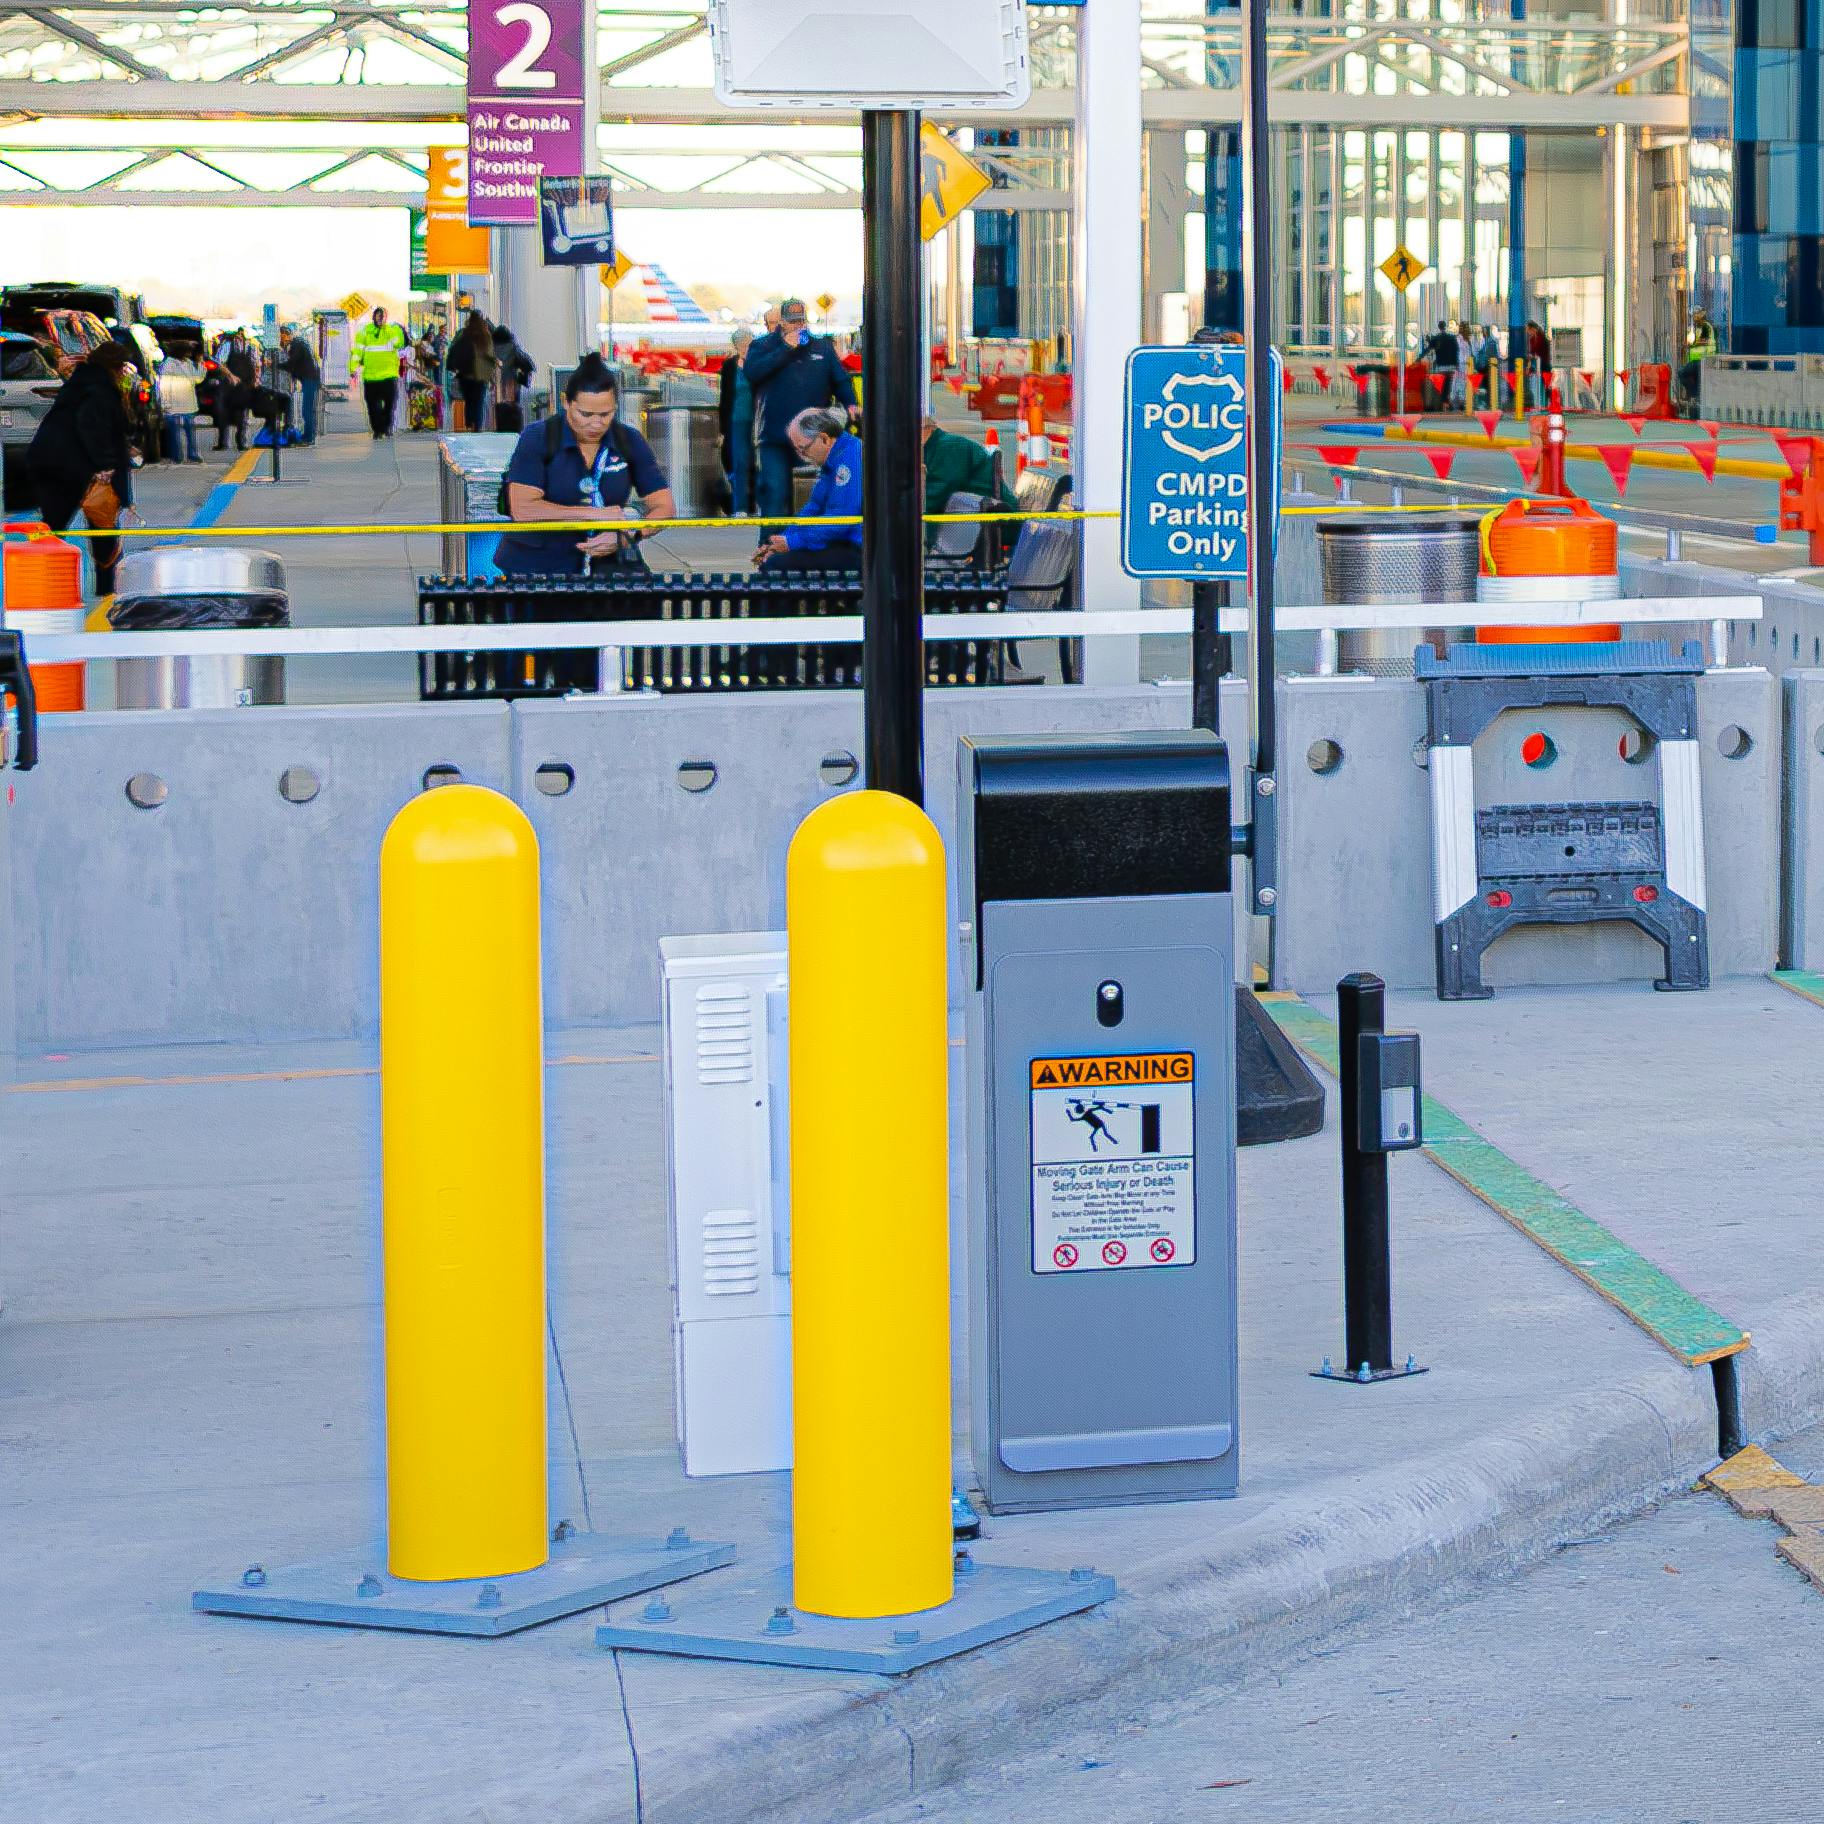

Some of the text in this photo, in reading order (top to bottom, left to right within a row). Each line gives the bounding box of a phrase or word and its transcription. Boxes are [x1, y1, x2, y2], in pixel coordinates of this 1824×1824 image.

[494, 2, 556, 88] 2
[474, 112, 571, 131] Air Canada
[474, 135, 534, 153] United
[443, 149, 468, 198] 3
[474, 157, 545, 175] Frontier
[474, 179, 538, 197] Southw
[1144, 402, 1244, 430] POLIC
[1156, 472, 1248, 497] CMPD
[1167, 530, 1238, 563] Only
[1059, 1057, 1189, 1084] WARNING
[1037, 1160, 1189, 1179] Moving Gate Arm Can Cause
[1052, 1175, 1174, 1192] Serious Injury or Death
